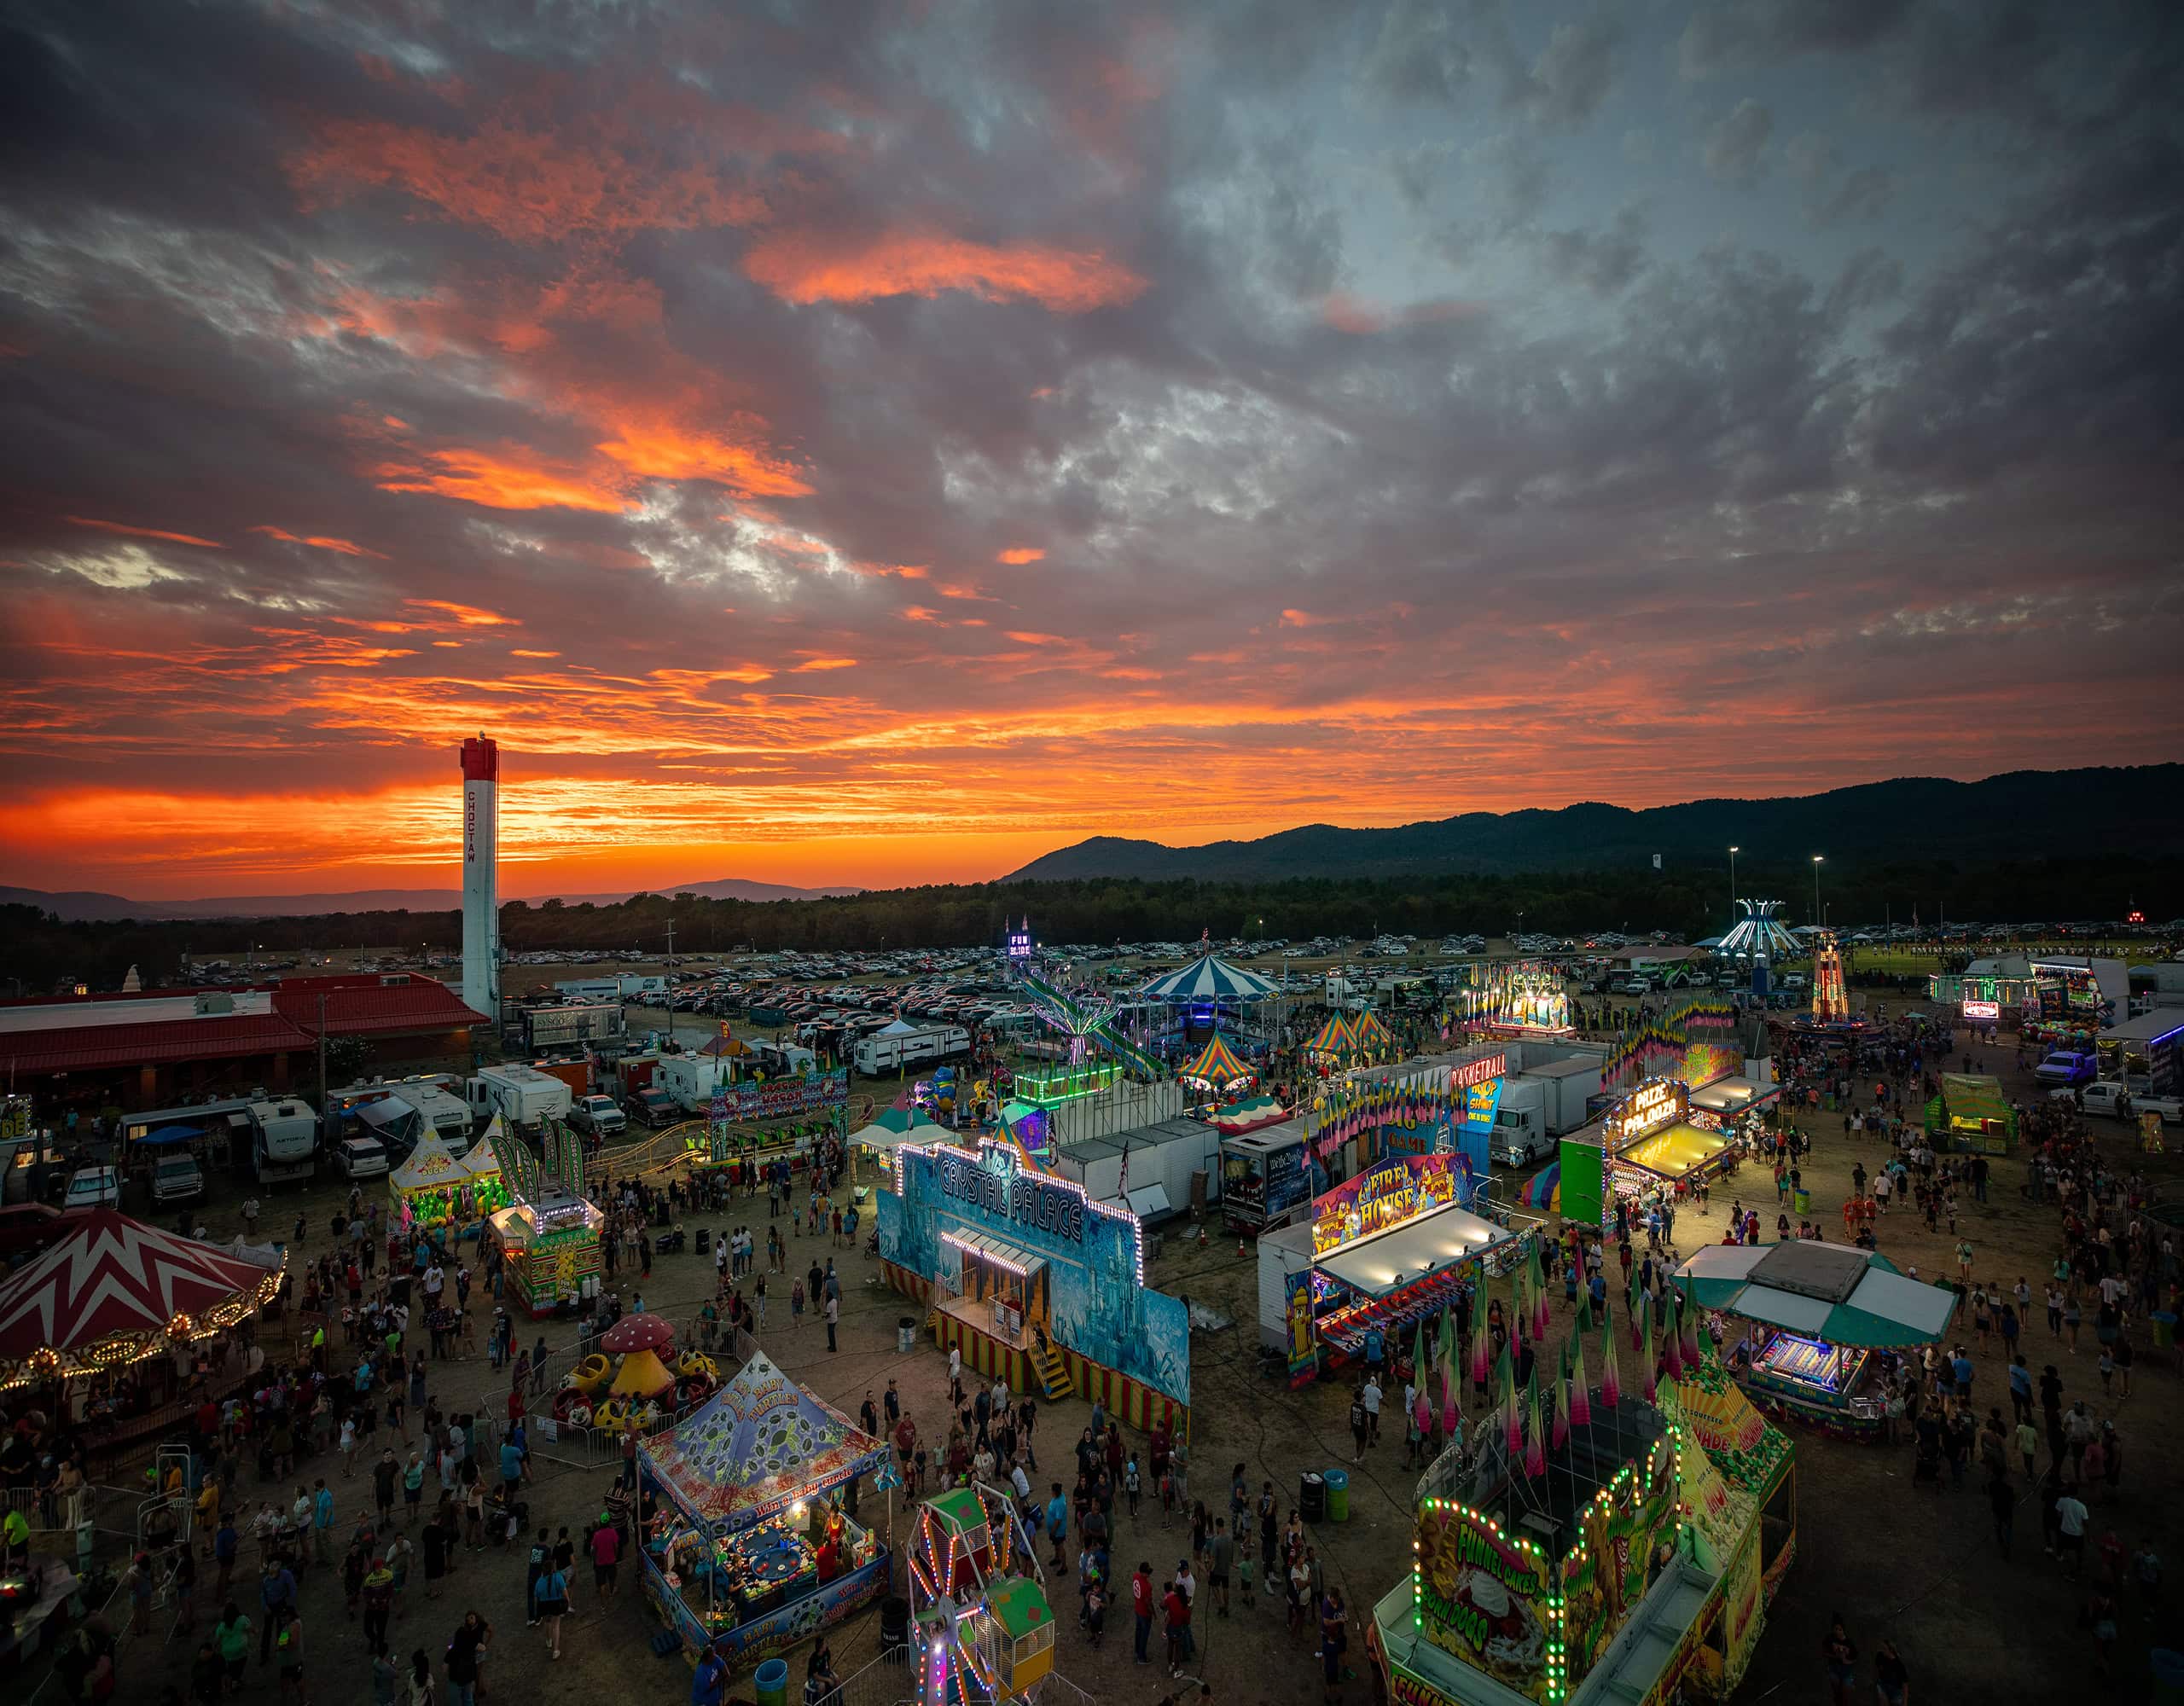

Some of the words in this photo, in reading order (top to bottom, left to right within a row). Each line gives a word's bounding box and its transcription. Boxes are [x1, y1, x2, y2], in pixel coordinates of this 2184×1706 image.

[1009, 946, 1030, 955] SLIDE
[1011, 936, 1027, 945] FUN
[1451, 1053, 1507, 1088] BASKETBALL
[760, 1079, 803, 1094] DRAGON
[762, 1091, 802, 1104] WAGON
[1472, 1081, 1497, 1095] HOOP
[1635, 1082, 1666, 1111] PRIZE
[1623, 1098, 1676, 1136] PALOOZA
[1387, 1132, 1427, 1153] GAME
[939, 1159, 1008, 1216] CRYSTAL
[1369, 1165, 1403, 1198] FIRE
[1010, 1180, 1083, 1242] PALACE
[1360, 1187, 1415, 1232] HOUSE
[752, 1378, 784, 1401] BABY
[746, 1393, 799, 1424] TURTLES
[1690, 1408, 1722, 1425] SQUEEZED
[754, 1500, 780, 1517] Win
[781, 1496, 791, 1506] a
[791, 1482, 819, 1502] baby
[822, 1467, 853, 1488] turtle
[1456, 1522, 1502, 1581] FUNNEL
[1504, 1564, 1539, 1595] CAKES
[744, 1621, 778, 1643] BABY
[1420, 1582, 1450, 1622] CORN
[1450, 1603, 1489, 1653] DOGS
